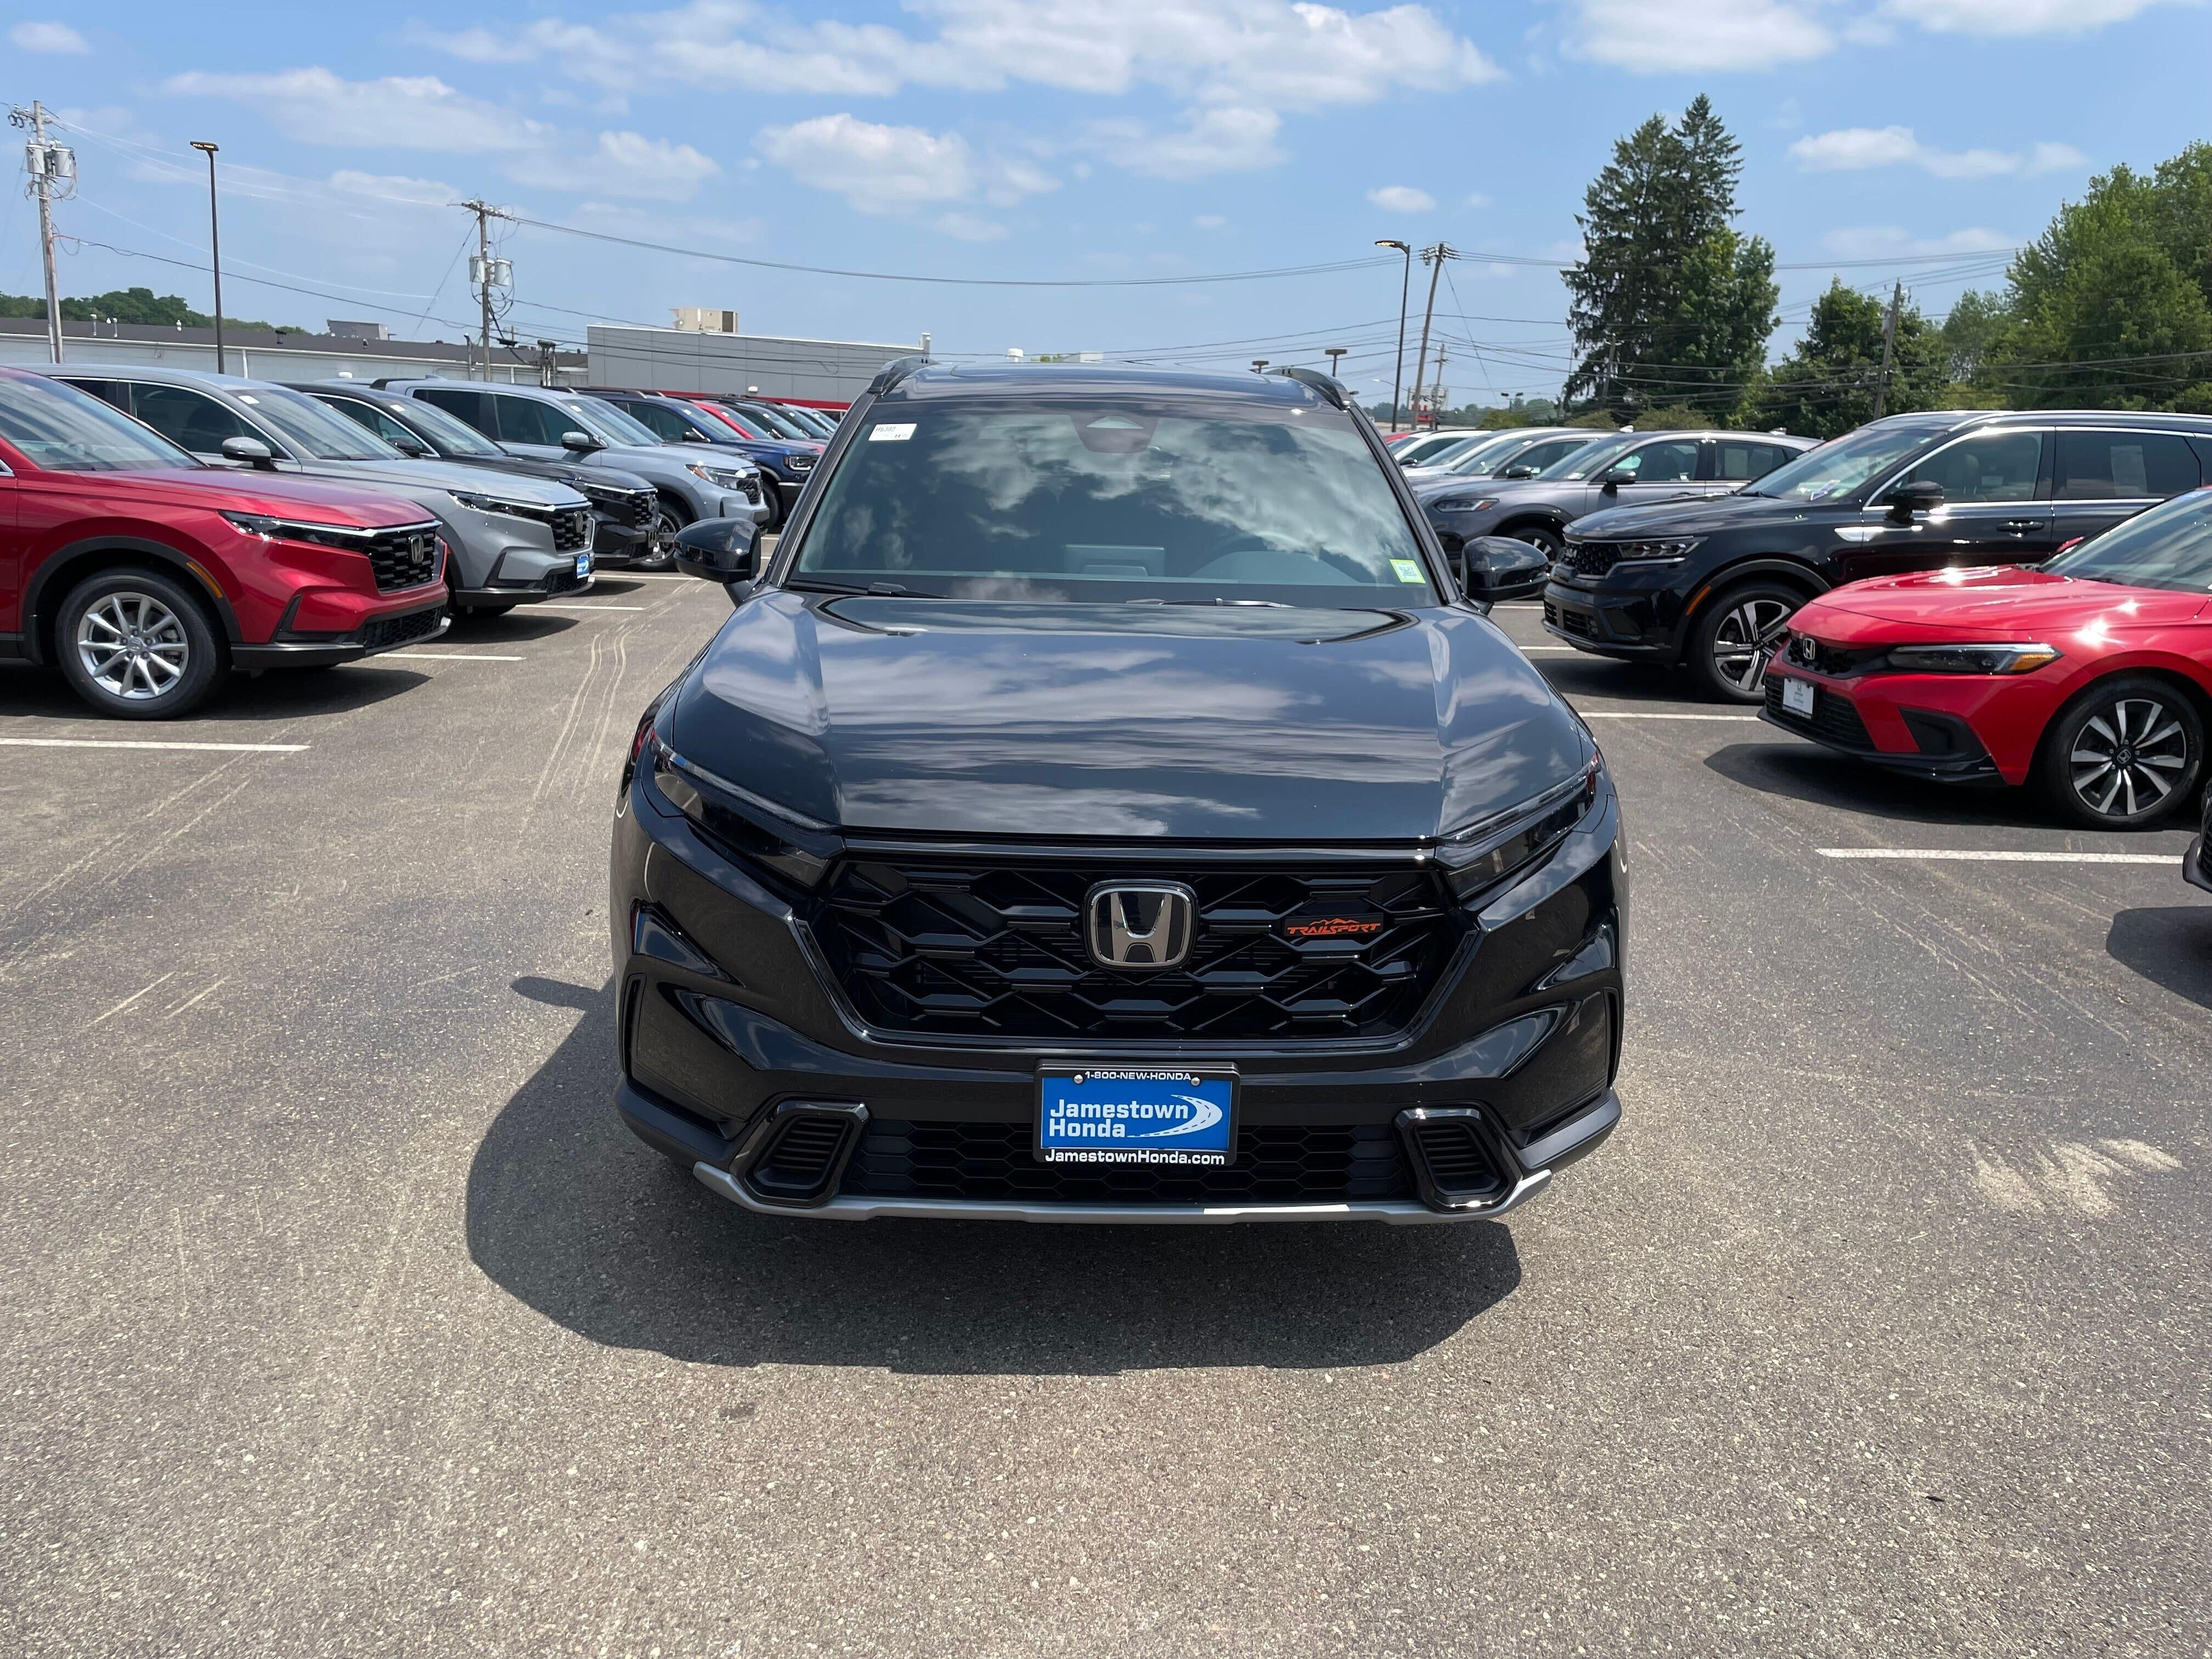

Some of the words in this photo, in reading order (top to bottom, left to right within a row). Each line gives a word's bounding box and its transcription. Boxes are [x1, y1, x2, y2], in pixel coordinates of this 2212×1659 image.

[1287, 923, 1381, 935] TRAILSPORT
[1085, 1071, 1192, 1081] 1-800-NEW-HONDA
[1050, 1099, 1189, 1119] Jamestown
[1049, 1118, 1126, 1138] Honda
[1045, 1149, 1225, 1165] JamestownHonda.com
